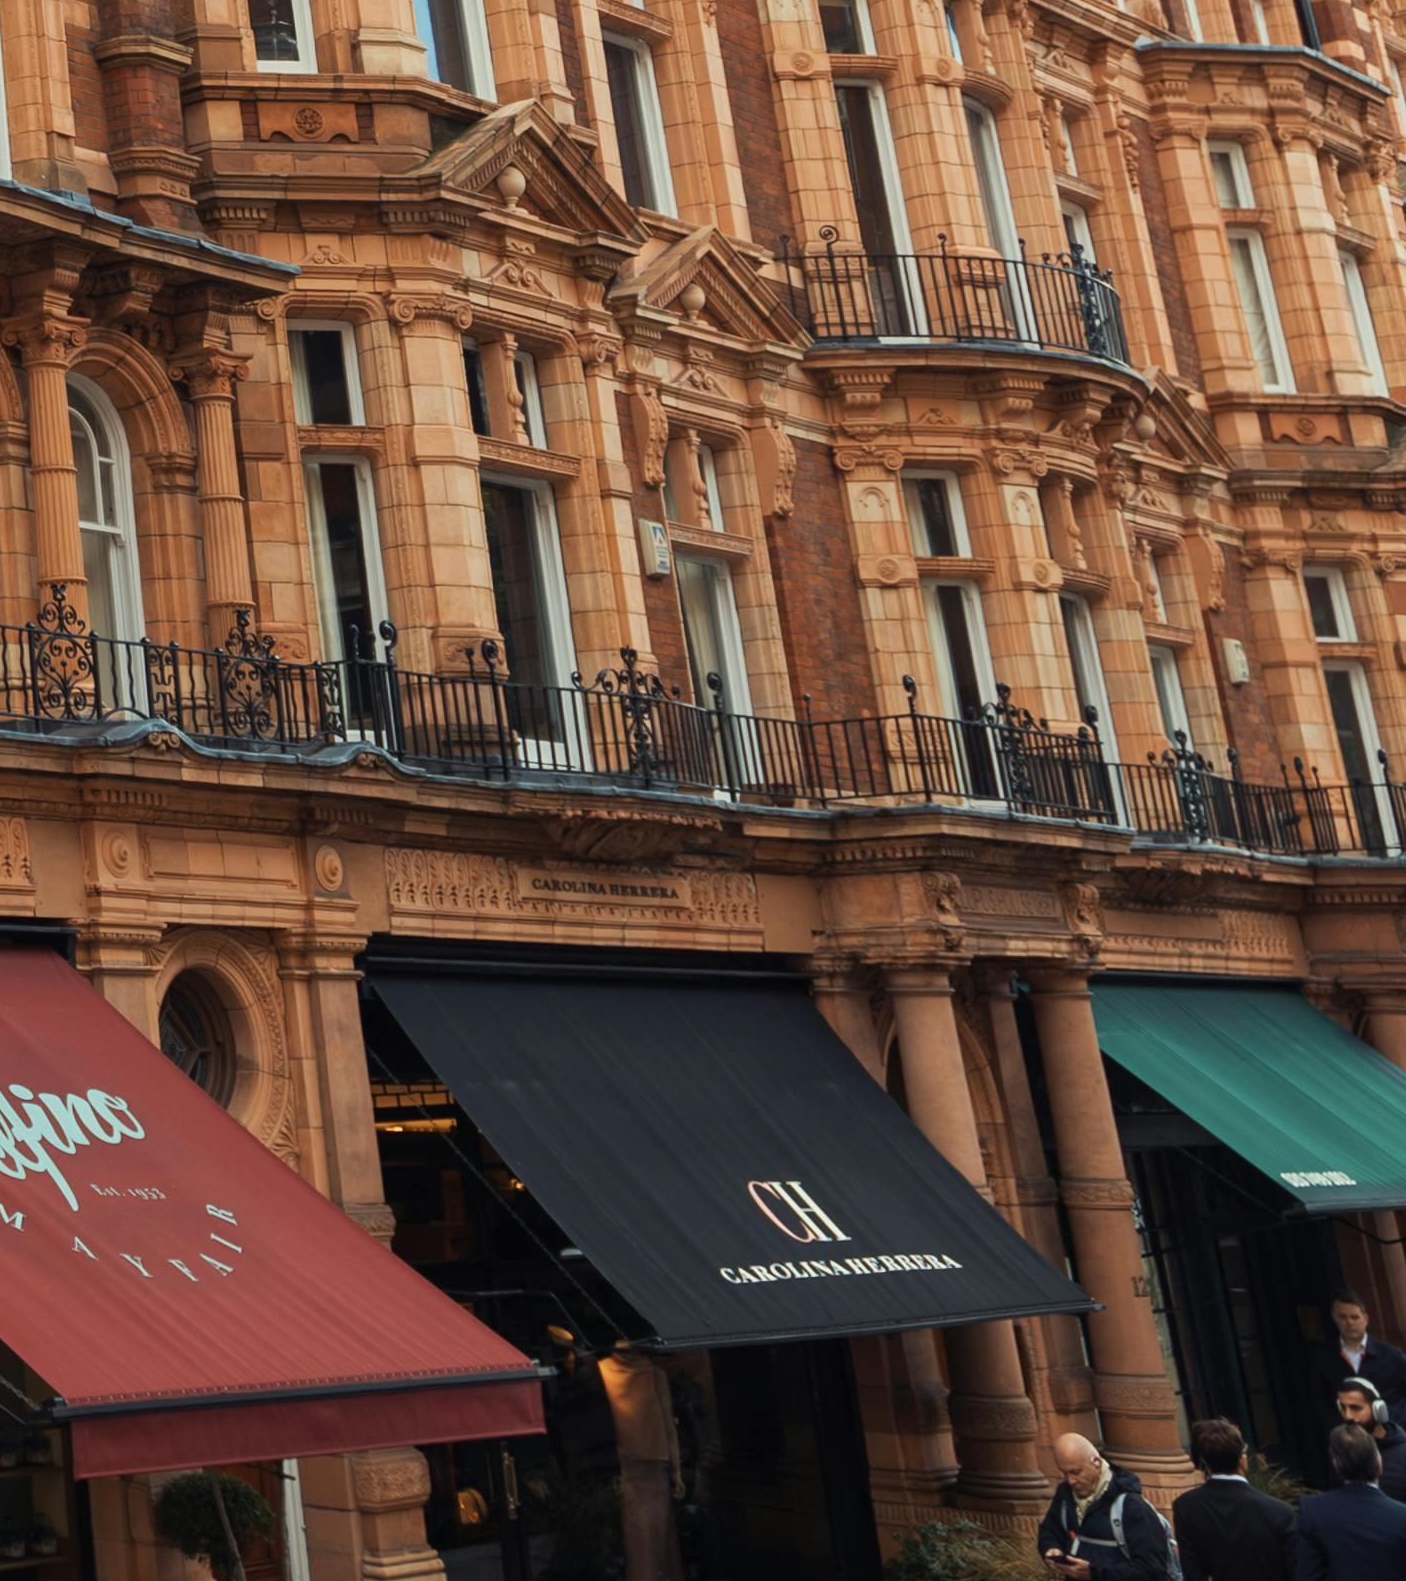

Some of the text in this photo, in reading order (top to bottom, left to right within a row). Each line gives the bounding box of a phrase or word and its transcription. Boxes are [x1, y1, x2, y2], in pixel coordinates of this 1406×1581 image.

[531, 878, 679, 899] CAROLINA HERRERA
[720, 1254, 963, 1284] CAROLINA HERRERA
